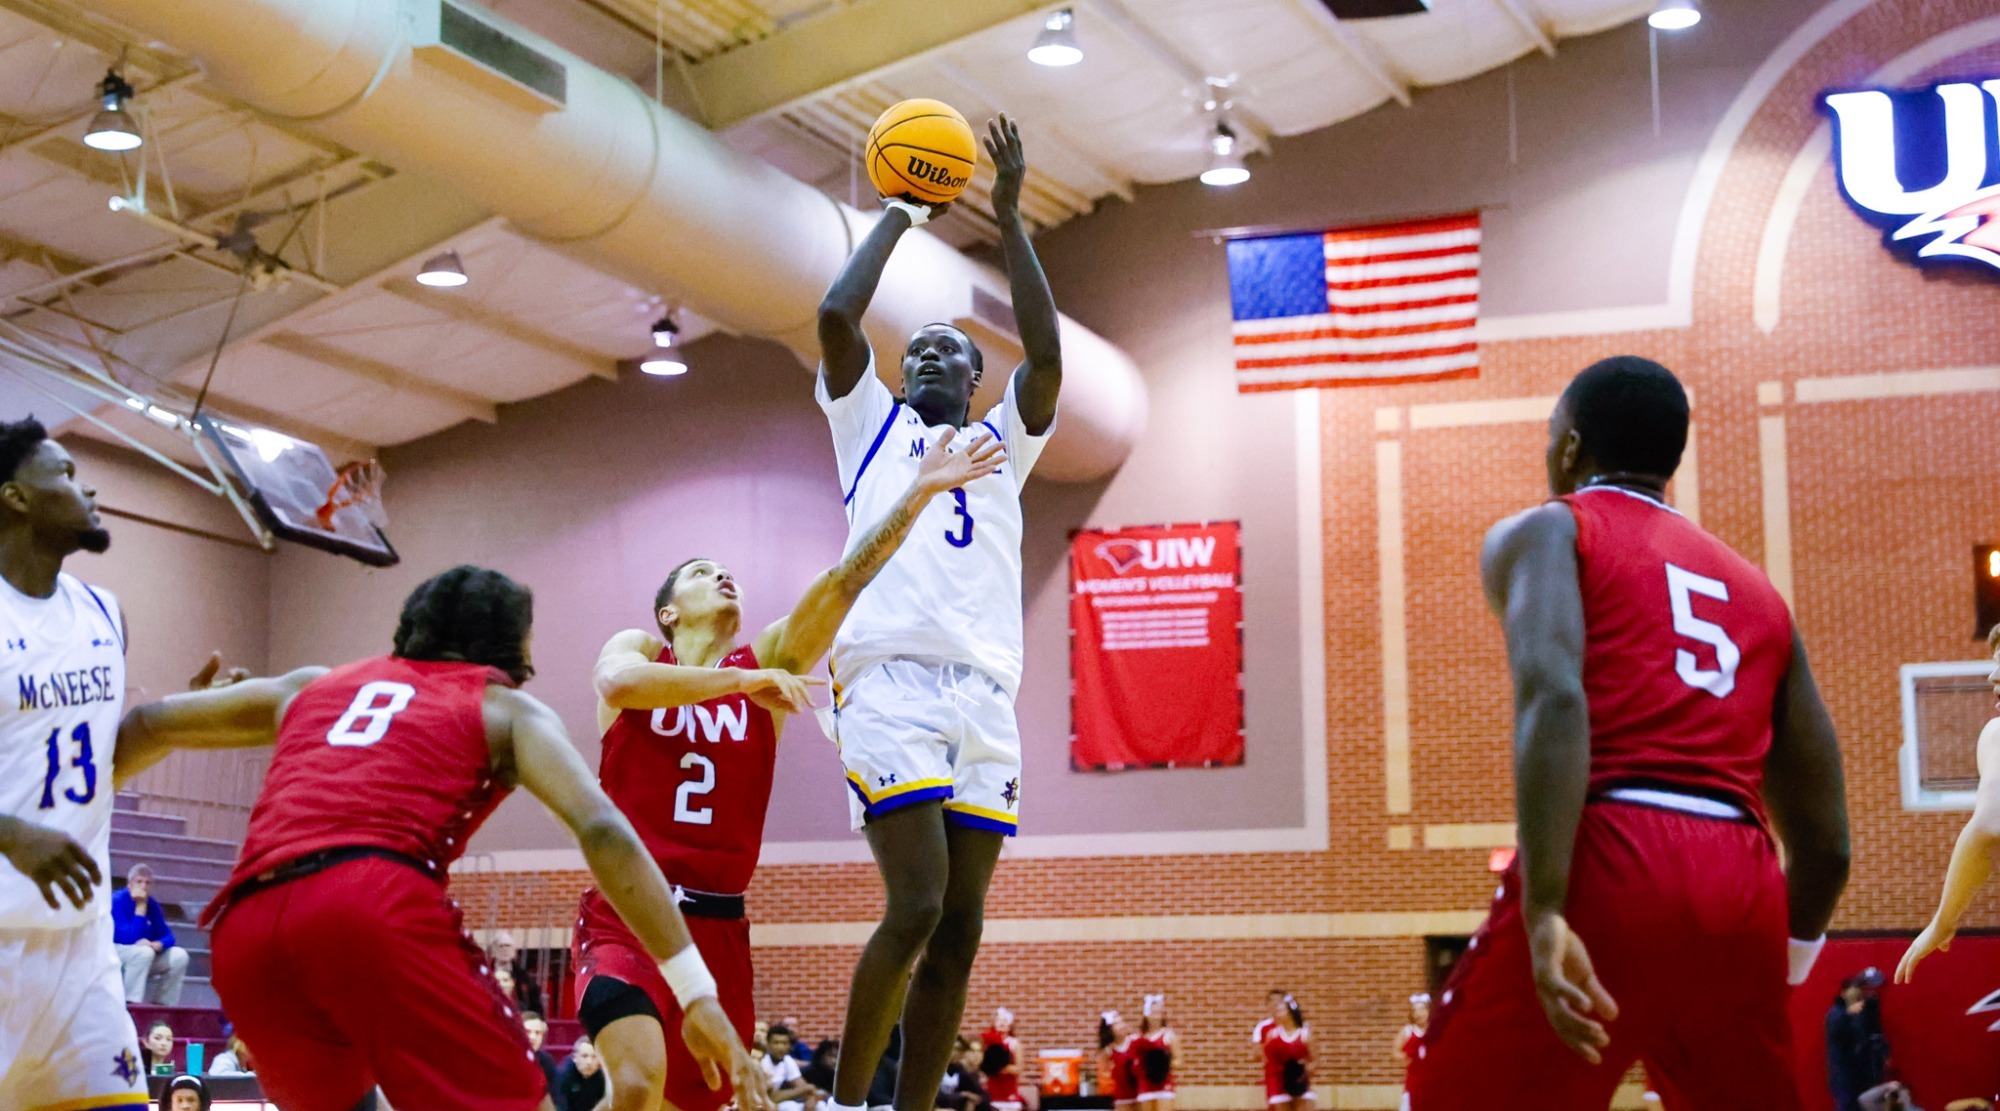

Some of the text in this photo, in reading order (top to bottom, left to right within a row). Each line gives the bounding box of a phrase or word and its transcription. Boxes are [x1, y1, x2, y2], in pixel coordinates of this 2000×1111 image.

[907, 155, 968, 188] Wilson
[1826, 78, 2000, 216] U
[945, 486, 974, 548] 3
[1138, 536, 1216, 569] UIW
[1149, 572, 1234, 592] VOLLEYBALL
[1664, 561, 1741, 699] 5
[325, 680, 417, 747] 8
[650, 699, 748, 743] UIW
[38, 721, 97, 810] 13
[673, 751, 716, 825] 2
